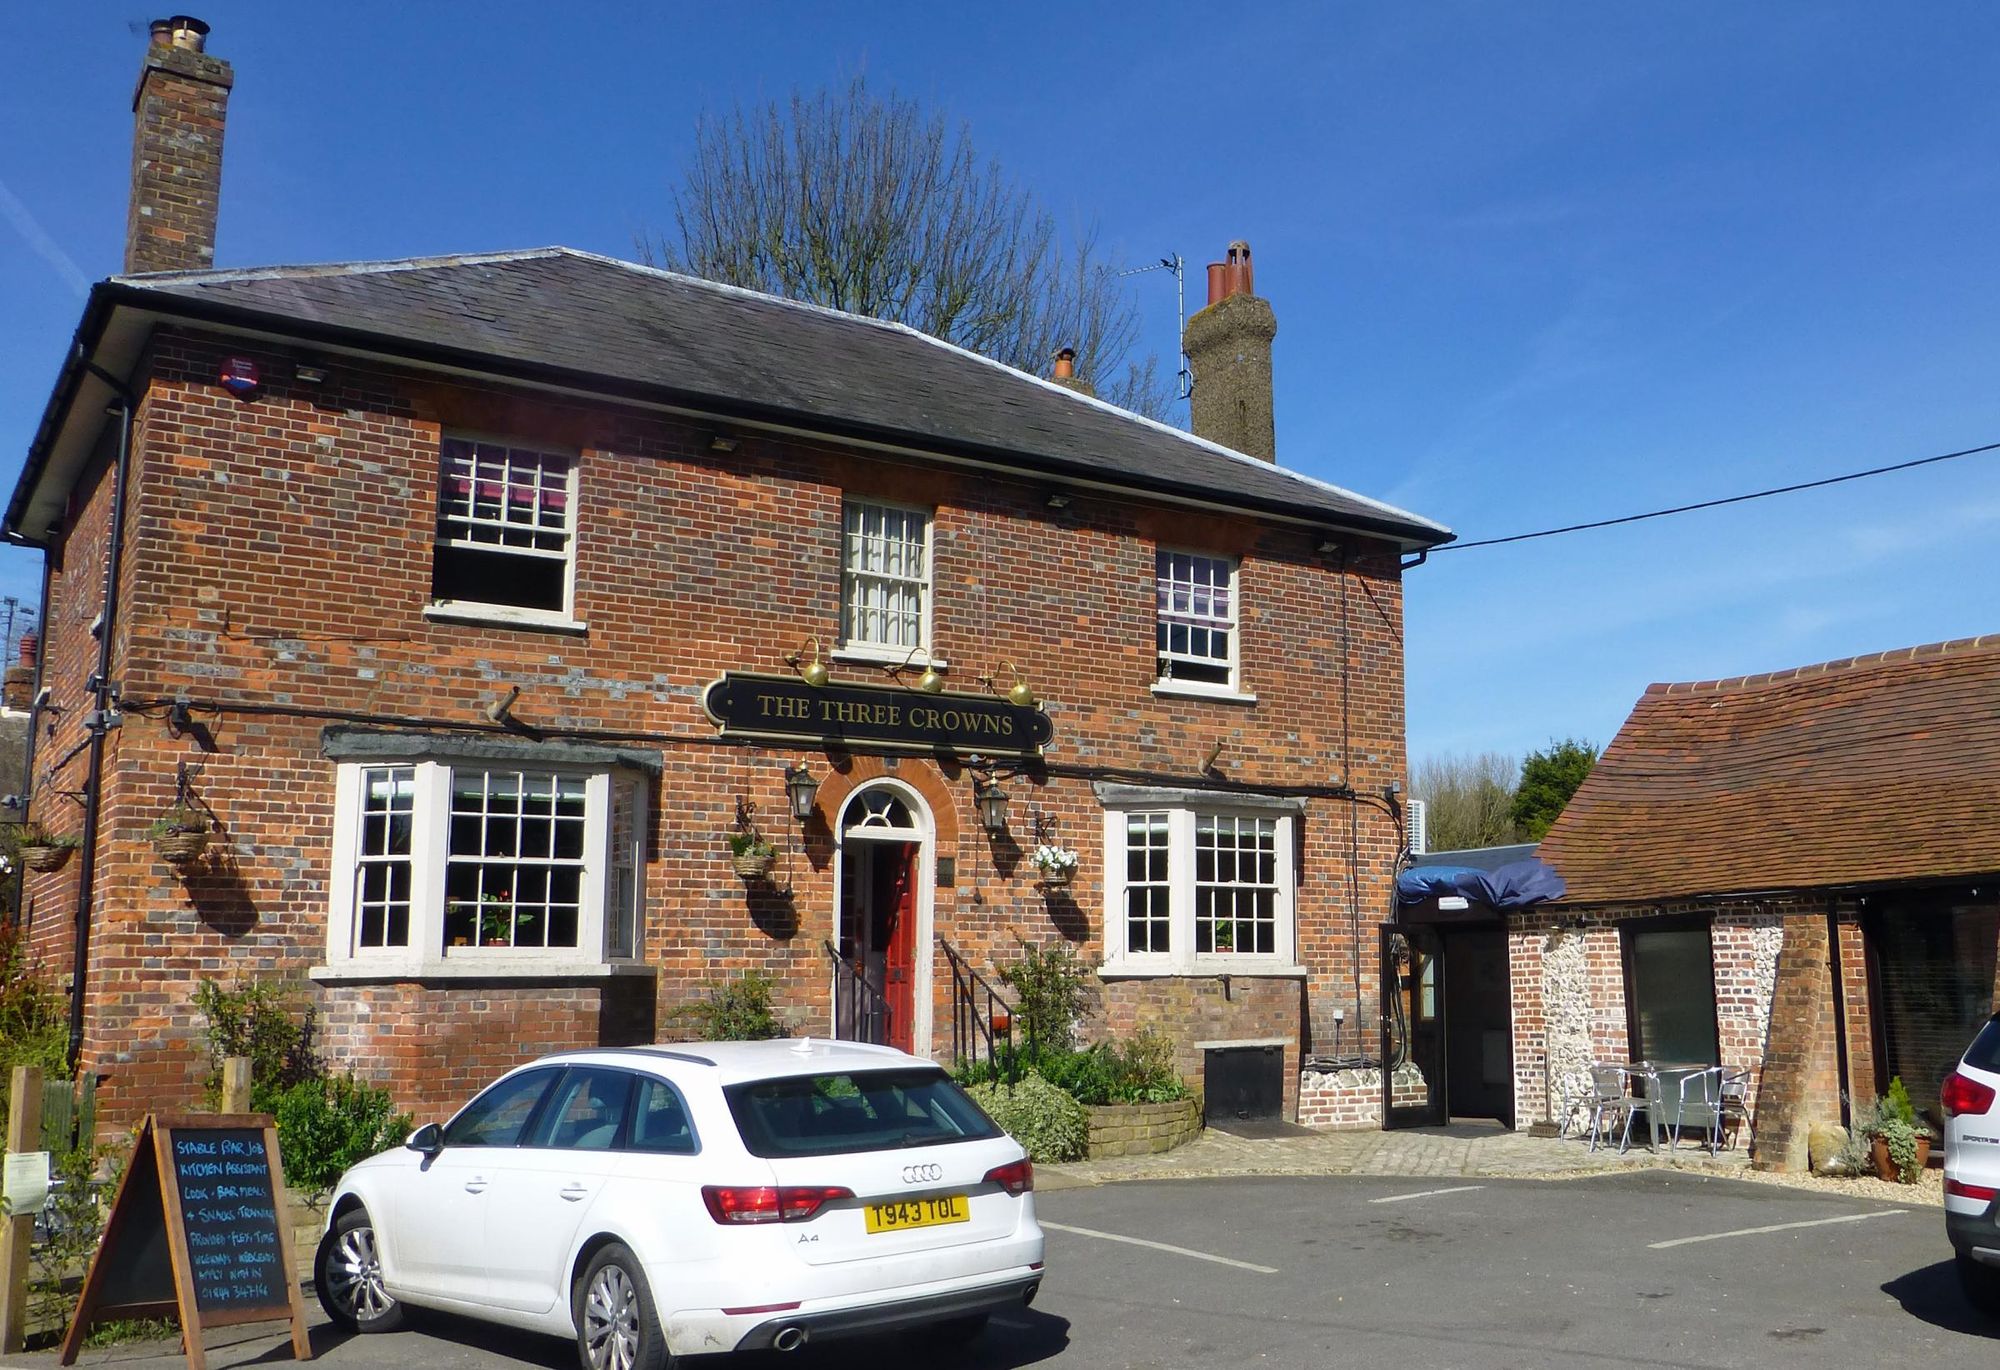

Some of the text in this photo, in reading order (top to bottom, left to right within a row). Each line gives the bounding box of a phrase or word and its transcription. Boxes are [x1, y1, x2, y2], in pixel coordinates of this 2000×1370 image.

[757, 695, 1014, 736] THE THREE CROWNS
[177, 1141, 217, 1155] STABLE
[221, 1140, 245, 1156] BAR
[180, 1162, 268, 1177] KITCHEN ASSISTANT
[217, 1186, 239, 1200] BAR
[239, 1186, 266, 1198] MEALS
[199, 1208, 236, 1223] SNACKS
[872, 1201, 922, 1227] T943
[798, 1233, 819, 1244] A4
